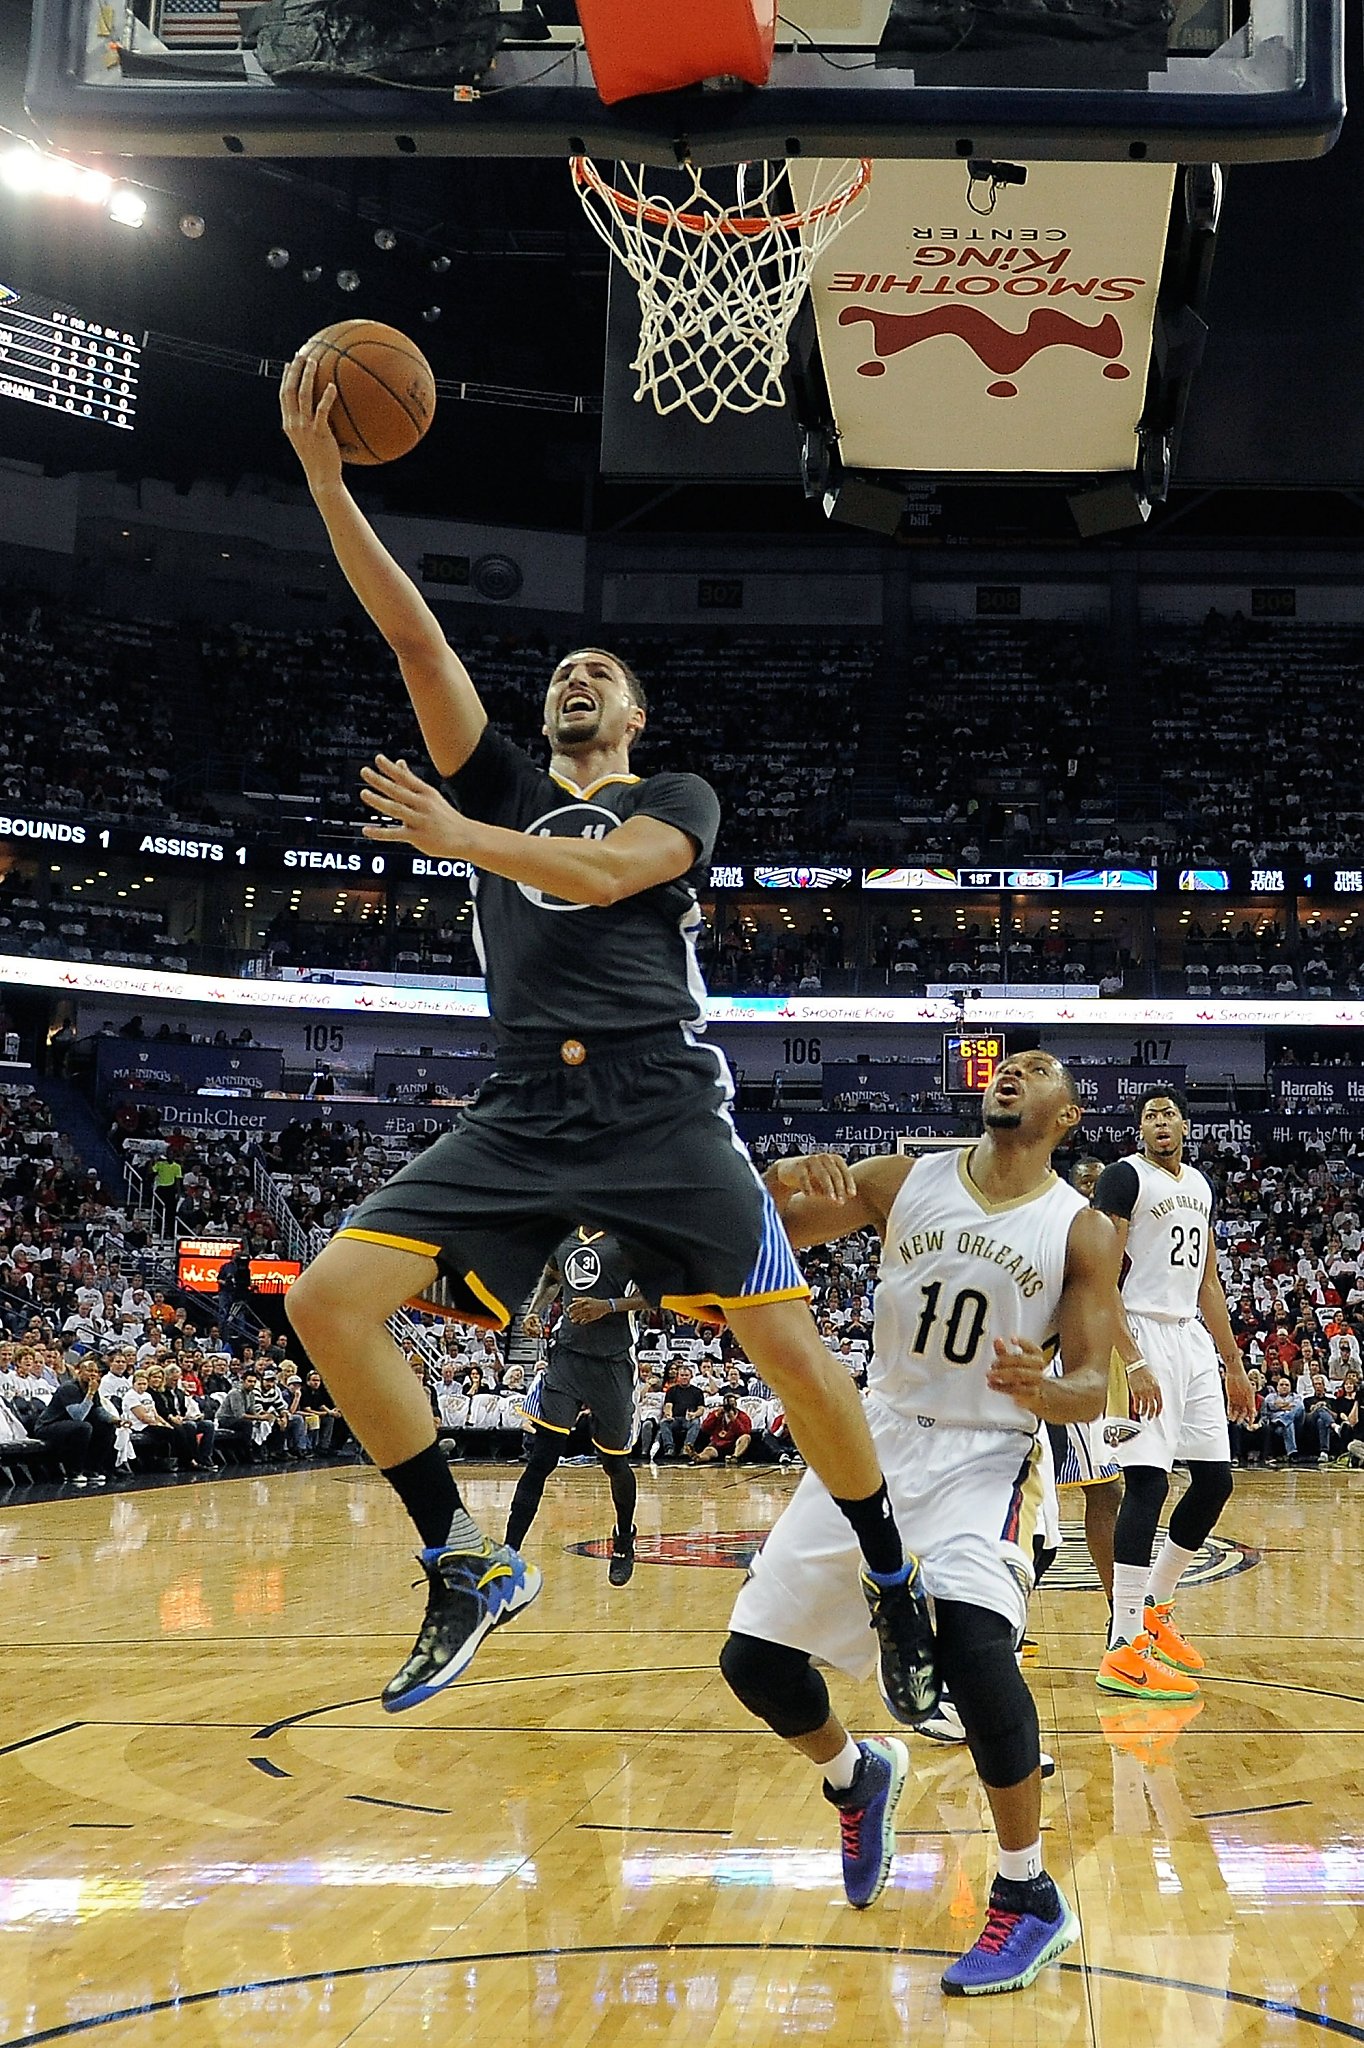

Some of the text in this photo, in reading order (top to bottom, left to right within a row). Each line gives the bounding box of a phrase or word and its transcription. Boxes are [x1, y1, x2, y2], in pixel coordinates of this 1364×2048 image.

[912, 228, 1068, 241] CENTER
[828, 271, 1147, 302] SMOOTHIE
[99, 830, 110, 848] 1
[139, 836, 247, 864] ASSISTS 1
[284, 850, 385, 873] STEALS 0
[711, 866, 742, 878] TEAM
[969, 874, 992, 884] 1ST
[1100, 870, 1122, 887] 12
[1251, 870, 1312, 888] TEAM 1
[1334, 871, 1363, 882] TIME
[709, 877, 744, 888] FOULS
[1250, 880, 1285, 891] FOULS
[1334, 881, 1363, 892] OUTS
[232, 988, 296, 1004] MOOTHIE
[802, 1006, 862, 1018] SMOOTHIE
[303, 1024, 344, 1052] 105
[783, 1038, 821, 1065] 106
[960, 1040, 998, 1057] 6:58
[1134, 1040, 1173, 1065] 107
[967, 1058, 993, 1088] 13
[1281, 1080, 1334, 1096] Harrah's
[1150, 1197, 1175, 1220] NEW
[1170, 1225, 1201, 1268] 23
[582, 1255, 595, 1270] 31
[899, 1230, 1044, 1298] NEW ORLEANS
[911, 1280, 990, 1366] 10
